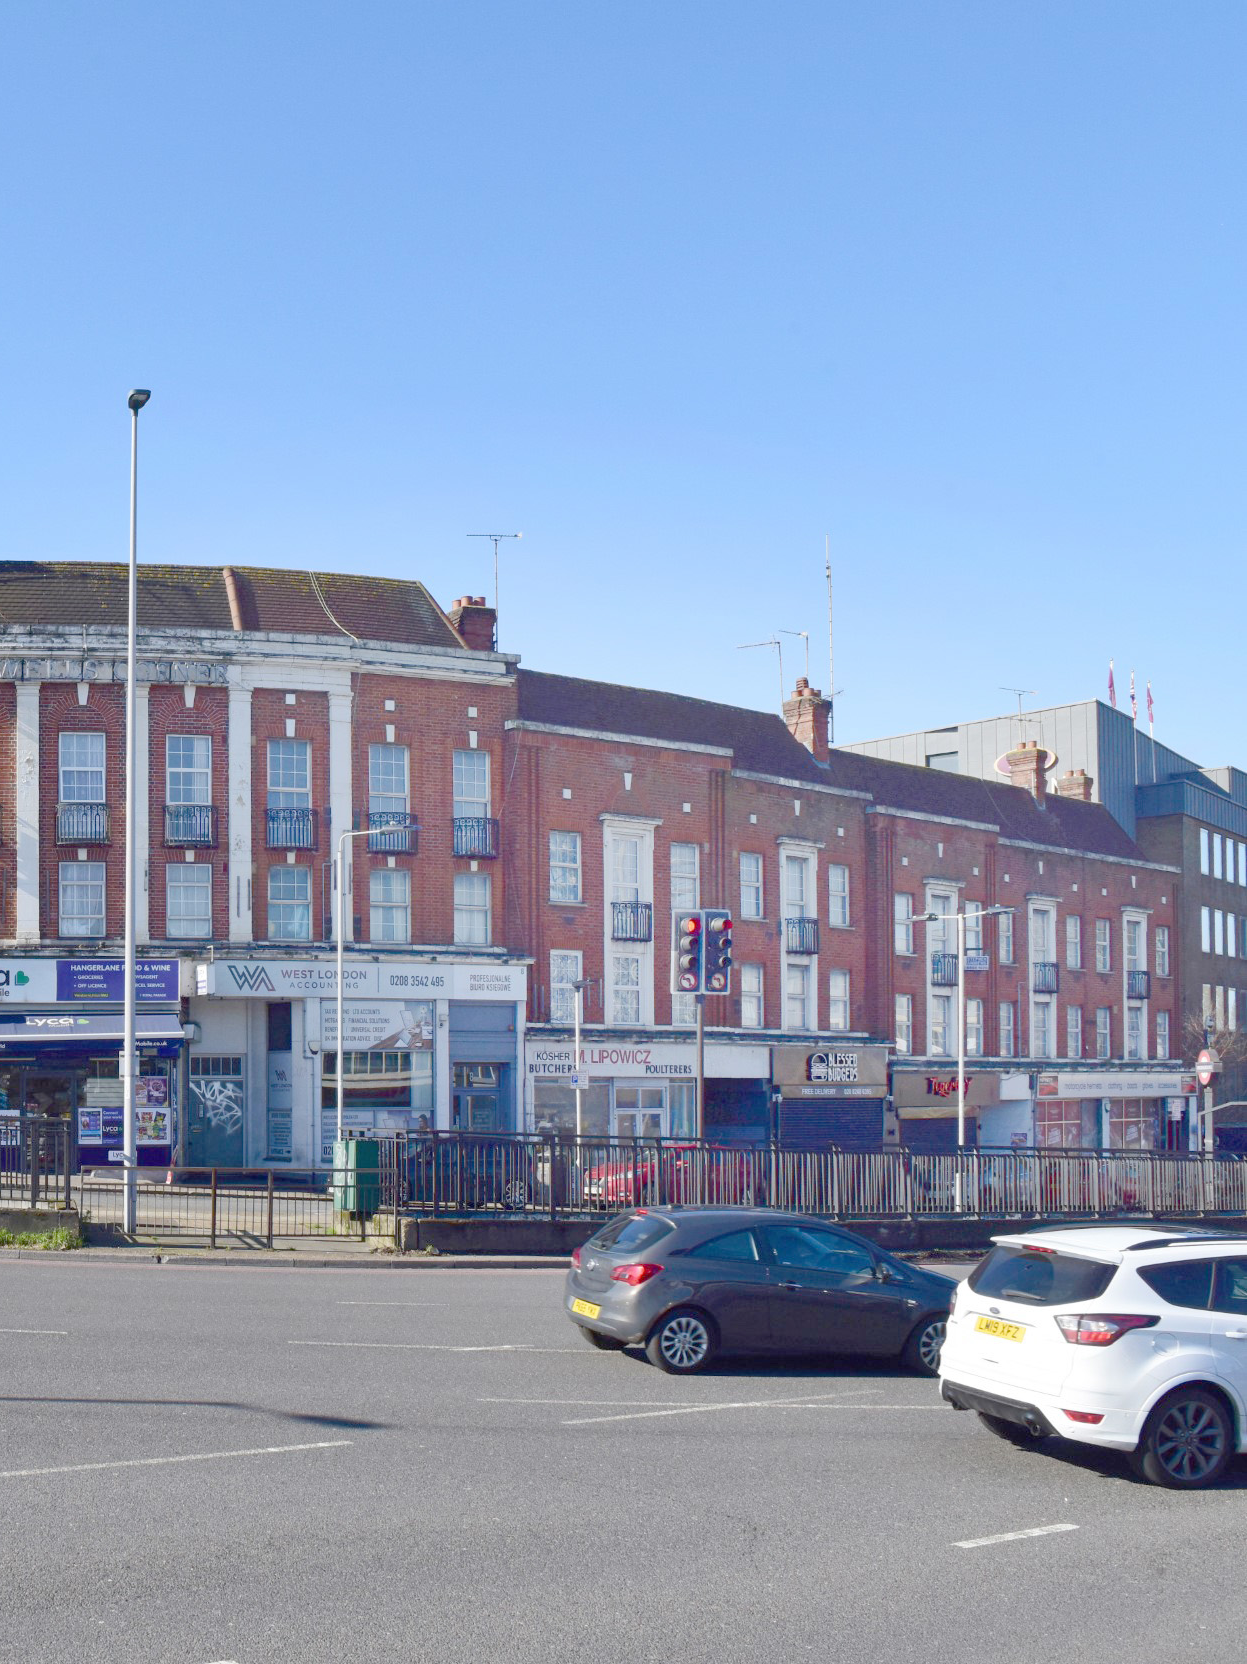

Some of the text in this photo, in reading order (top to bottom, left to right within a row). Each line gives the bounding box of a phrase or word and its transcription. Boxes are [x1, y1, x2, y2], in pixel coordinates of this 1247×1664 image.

[113, 661, 229, 683] CORNER
[70, 964, 120, 972] HANGERLANE
[151, 964, 171, 972] WINE
[281, 969, 367, 980] WEST LONDON
[289, 981, 359, 989] ACCOUNTNG
[390, 975, 445, 987] 0208 3542 495
[25, 1016, 74, 1027] Lyca
[536, 1051, 570, 1061] KOSHER
[590, 1050, 652, 1064] LIPOWICZ
[828, 1053, 858, 1067] BLESSED
[645, 1065, 692, 1074] POULTERERS
[827, 1067, 858, 1081] BURGERS
[999, 1323, 1020, 1339] XFZ
